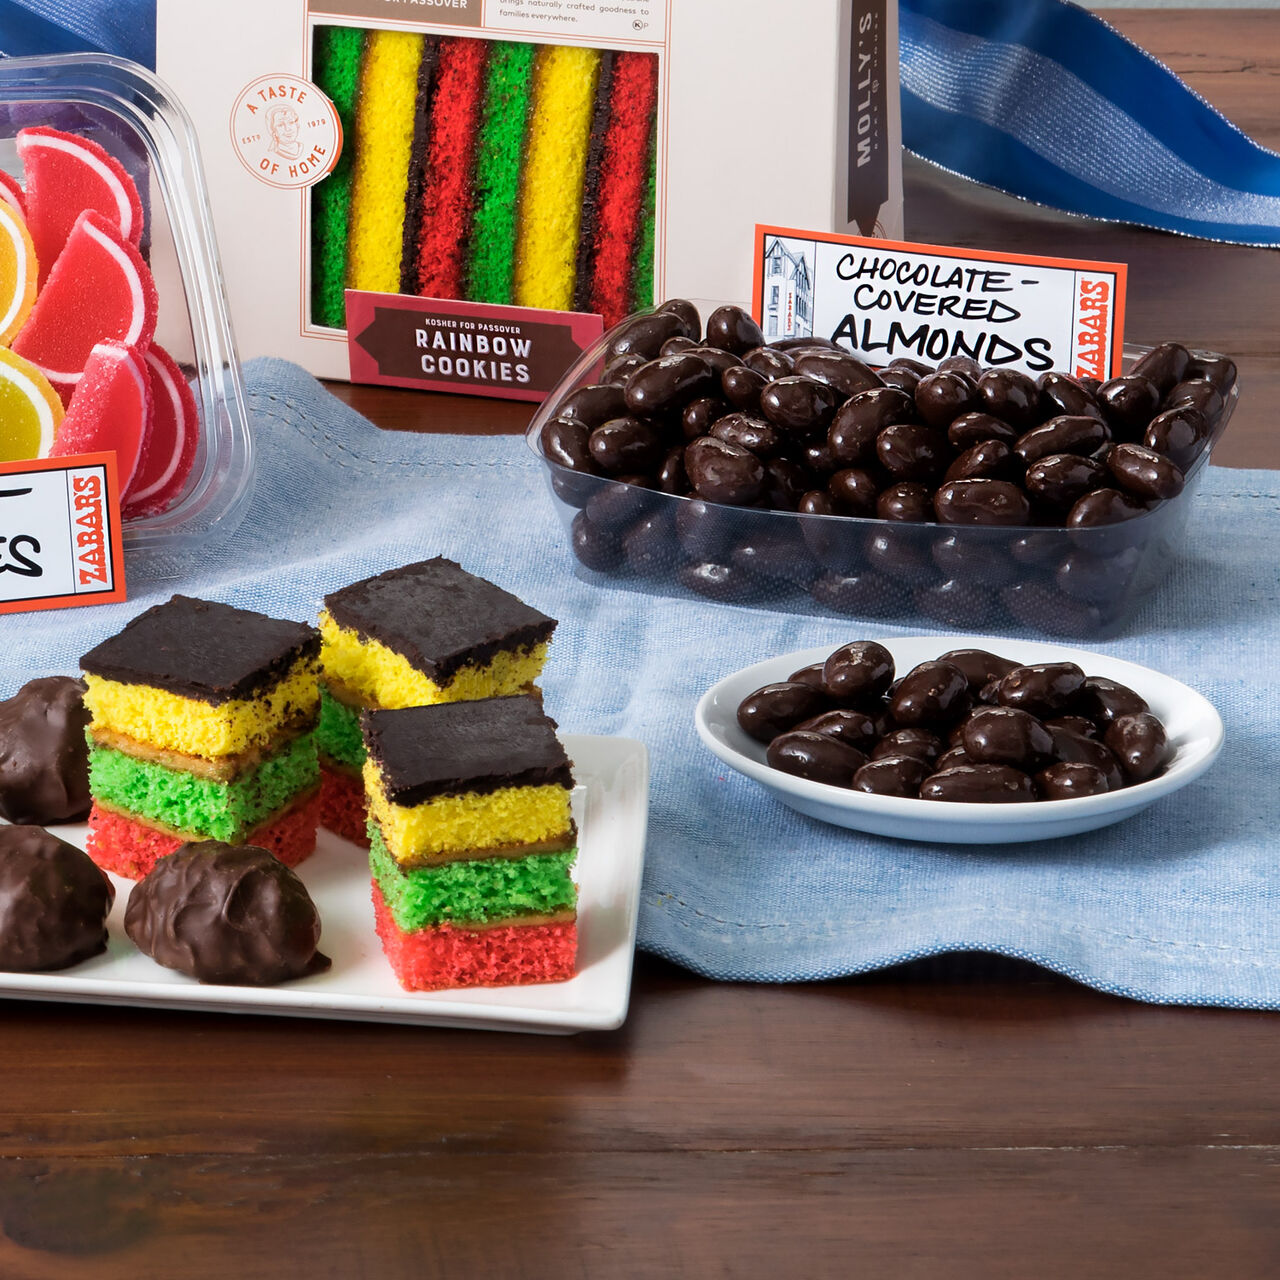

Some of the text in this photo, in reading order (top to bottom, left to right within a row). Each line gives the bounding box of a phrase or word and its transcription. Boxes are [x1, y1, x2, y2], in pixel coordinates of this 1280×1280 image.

[246, 85, 307, 115] A TASTE
[857, 12, 872, 168] MOLLY'S
[260, 145, 326, 178] OF HOME
[853, 284, 1021, 322] COVERED
[425, 318, 521, 335] KOSHER FOR PASSOVER
[831, 313, 1054, 371] ALMONDS
[415, 329, 532, 359] RAINBOW
[421, 354, 531, 384] COOKIES
